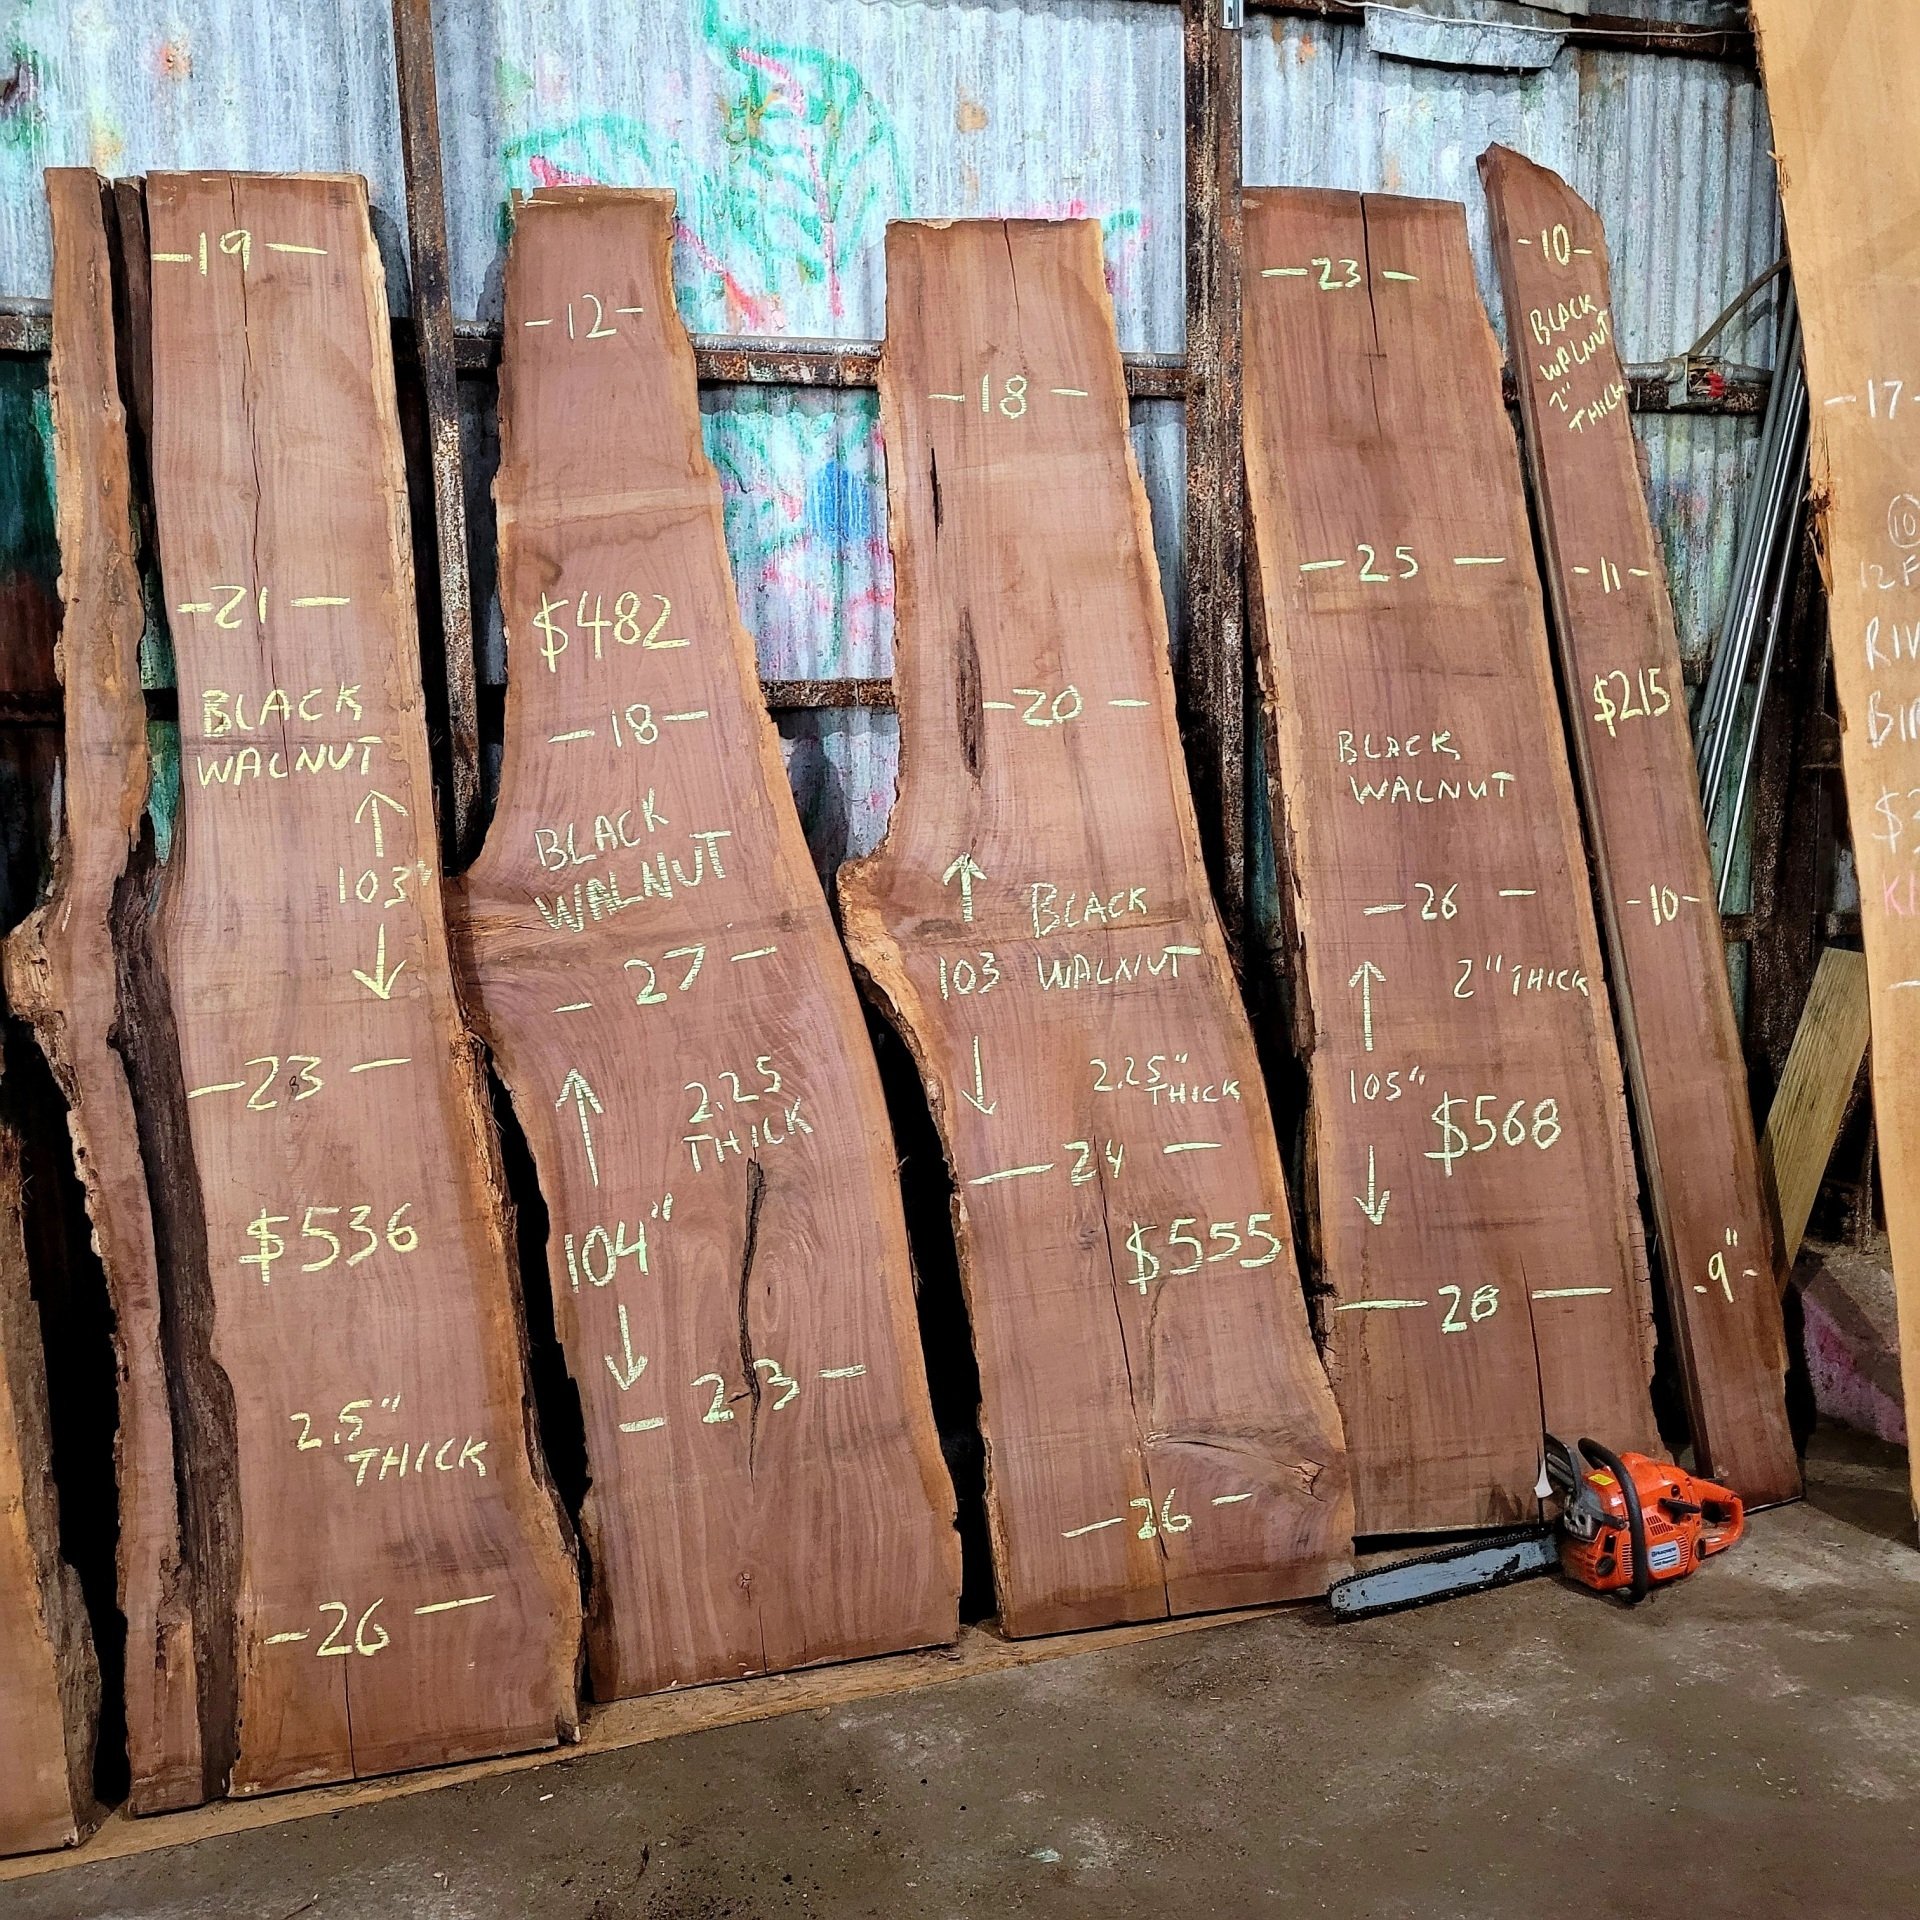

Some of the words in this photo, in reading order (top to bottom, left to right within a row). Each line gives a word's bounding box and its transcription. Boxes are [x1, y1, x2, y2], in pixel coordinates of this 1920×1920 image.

[1529, 293, 1597, 346] BLACK
[1539, 309, 1609, 381] WALNUT
[1568, 383, 1627, 434] THICK
[1860, 559, 1896, 589] 12
[532, 589, 692, 673] $482
[202, 681, 364, 738] BLACK
[1593, 667, 1672, 739] $215
[196, 734, 383, 789] WALNUT
[1338, 730, 1461, 765] BLACK
[1349, 771, 1516, 805] WALNUT
[533, 787, 670, 872] BLACK
[534, 829, 732, 934] WALNUT
[1031, 882, 1149, 939] BLACK
[939, 951, 1001, 1001] 103
[1037, 945, 1202, 992] WALNUT
[1453, 954, 1503, 999] 2"
[1511, 964, 1590, 997] THICK
[1089, 1052, 1189, 1093] 2.25"
[1144, 1079, 1241, 1106] THICK
[1349, 1065, 1427, 1104] 105"
[681, 1097, 814, 1173] THICK
[1423, 1090, 1563, 1178] $568
[238, 1202, 420, 1286] $536
[564, 1192, 674, 1294] 104"
[1125, 1212, 1283, 1296] $555
[345, 1435, 489, 1487] THICK
